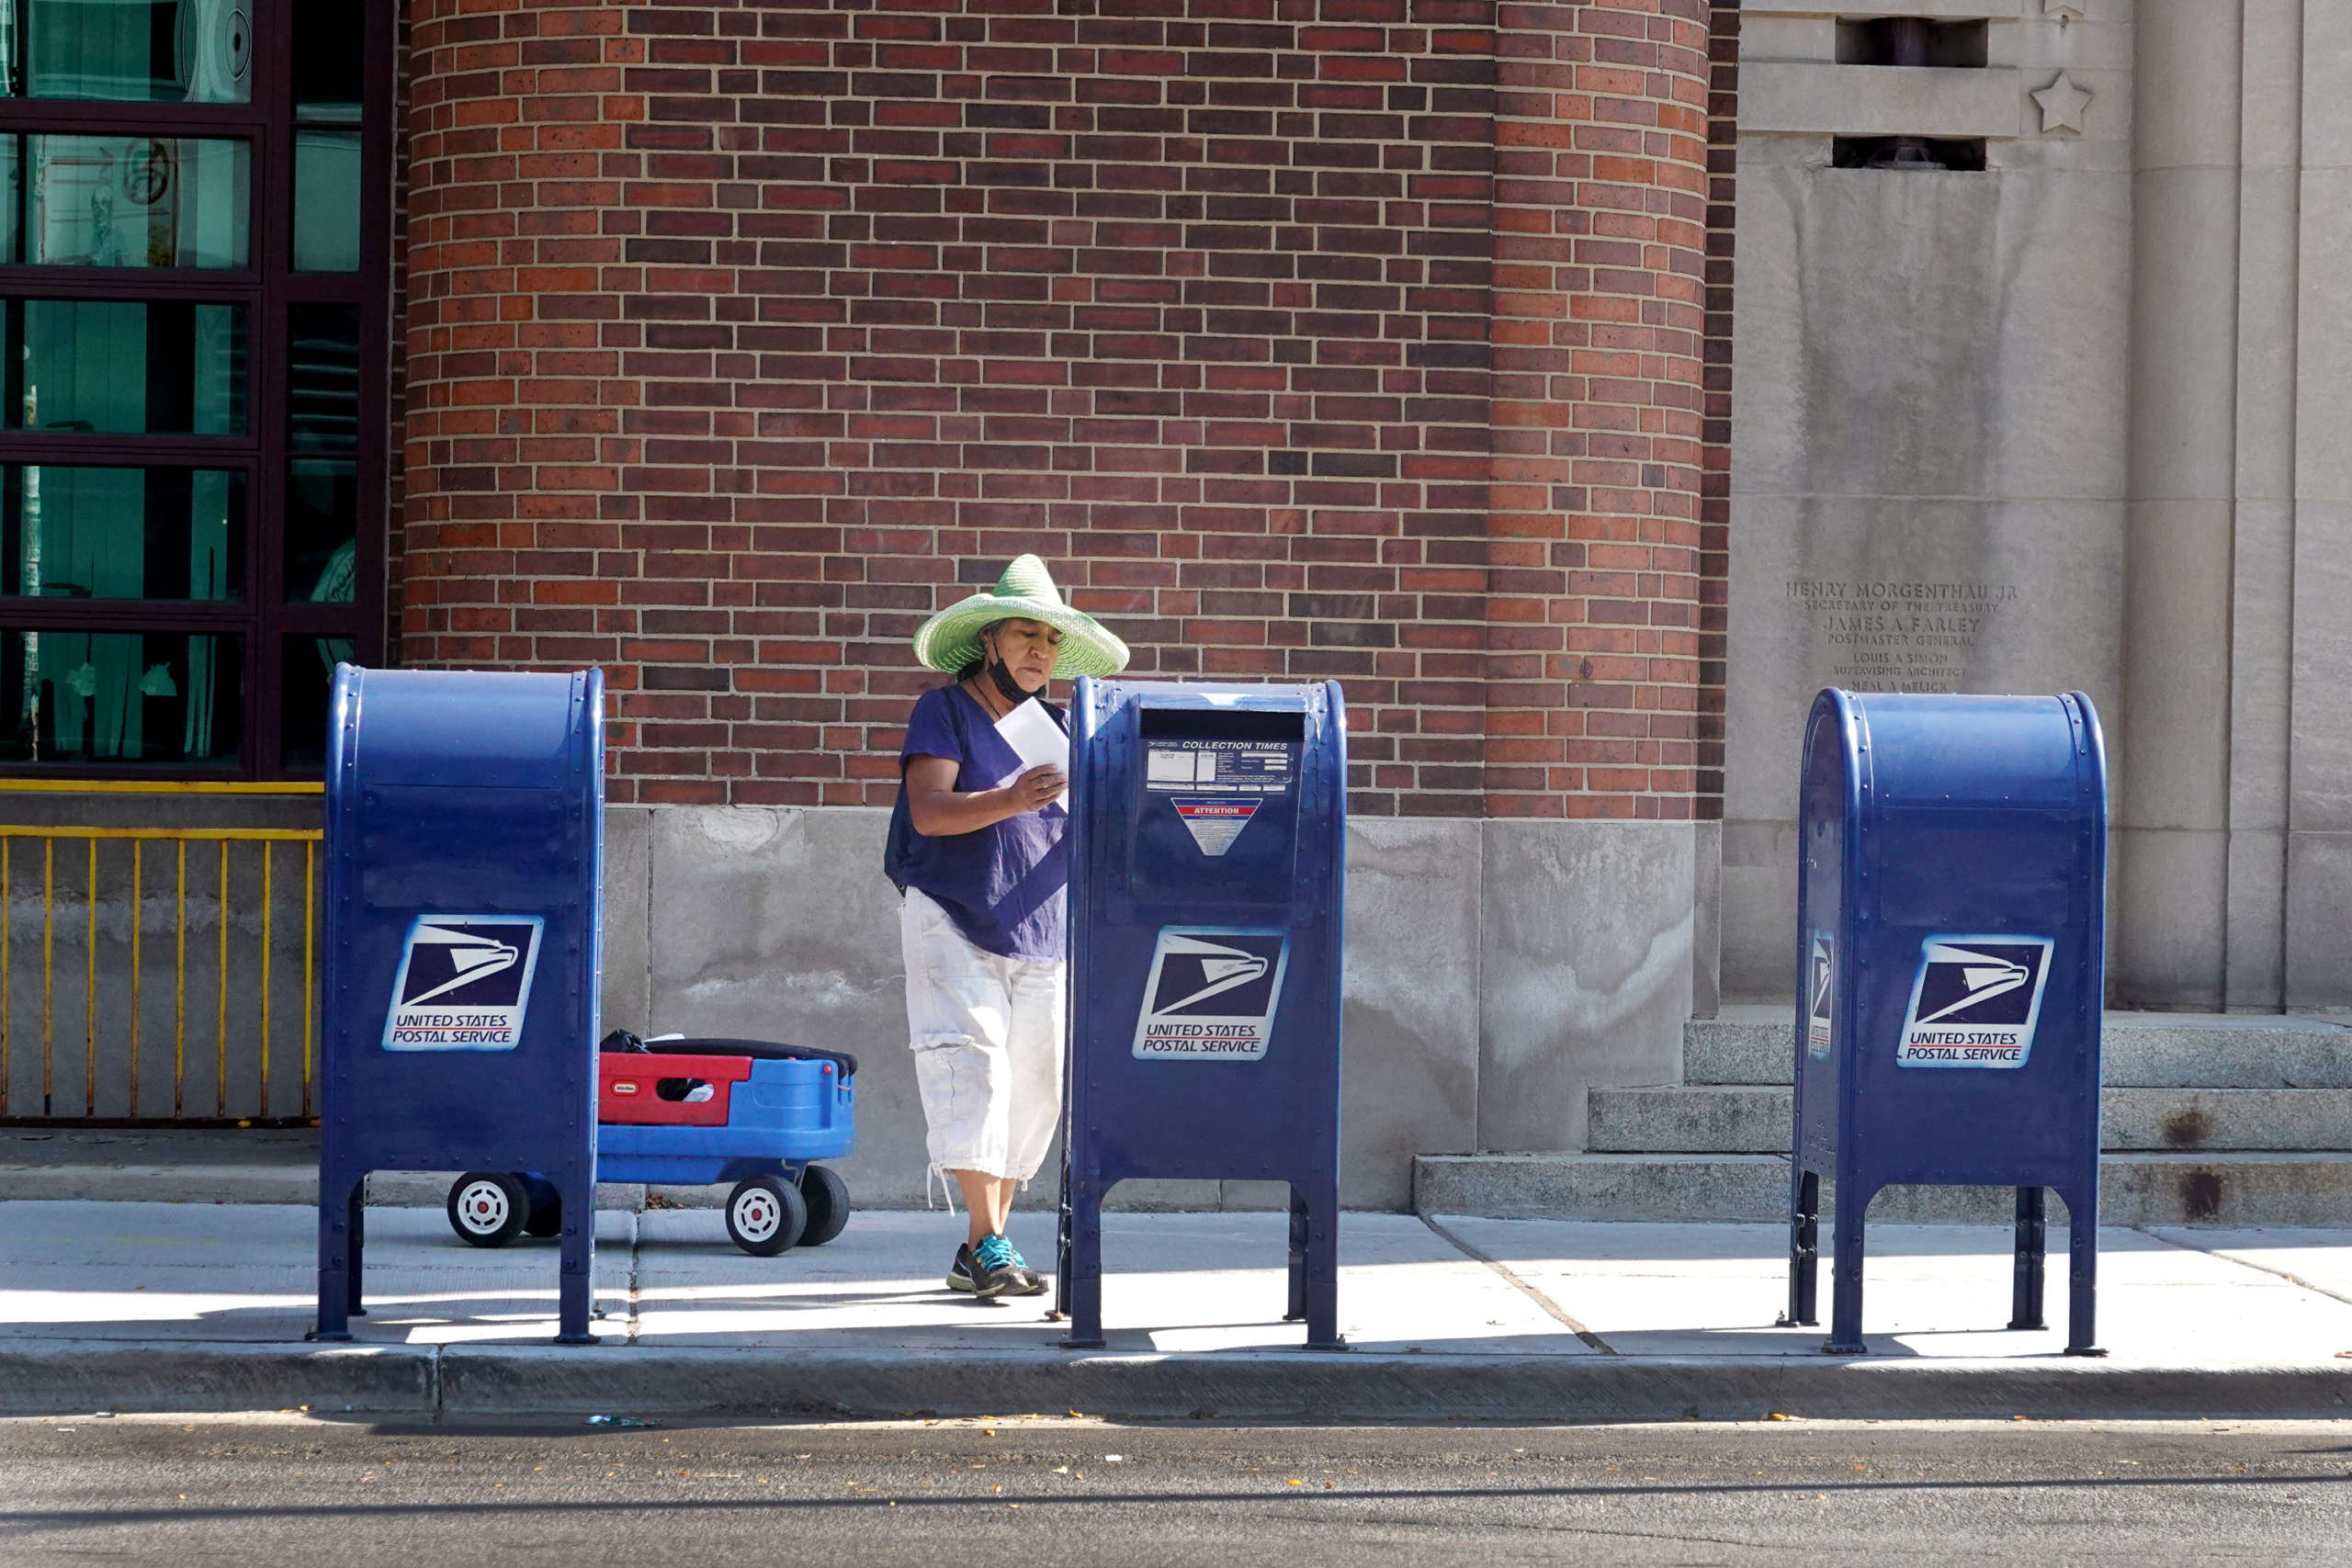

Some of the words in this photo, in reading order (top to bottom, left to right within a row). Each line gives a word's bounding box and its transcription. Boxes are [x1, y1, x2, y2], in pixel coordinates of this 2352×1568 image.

[1786, 581, 1847, 597] HENRY
[1856, 582, 1987, 599] MORGENTHAU
[1996, 585, 2018, 601] JR
[1804, 601, 1875, 611] SECRETARY
[1881, 602, 1898, 612] OF
[1905, 602, 1929, 612] THE
[1935, 603, 1998, 614] TREASURY
[1822, 616, 1883, 632] JAMES
[1894, 617, 1905, 632] A
[1911, 617, 1980, 633] FARLEY
[1827, 634, 1910, 646] POSTMASTER
[1917, 636, 1974, 647] GENERAL
[1853, 653, 1890, 663] LOUIS
[1907, 654, 1949, 663] SIMON
[1833, 666, 1902, 677] SUPERVISING
[1906, 667, 1968, 678] ARCHITECT
[1182, 741, 1252, 750] COLLECTION
[1256, 742, 1288, 750] TIMES
[396, 1015, 453, 1027] UNITED
[455, 1015, 507, 1027] STATES
[393, 1031, 447, 1043] POSTAL
[451, 1031, 512, 1043] SERVICE
[1147, 1024, 1203, 1036] UNITED
[1204, 1025, 1256, 1037] STATES
[1910, 1032, 1965, 1044] UNITED
[1967, 1033, 2018, 1044] STATES
[1143, 1040, 1197, 1052] POSTAL
[1201, 1040, 1261, 1053] SERVICE
[1906, 1048, 1958, 1059] POSTAL
[1962, 1048, 2021, 1061] SERVICE
